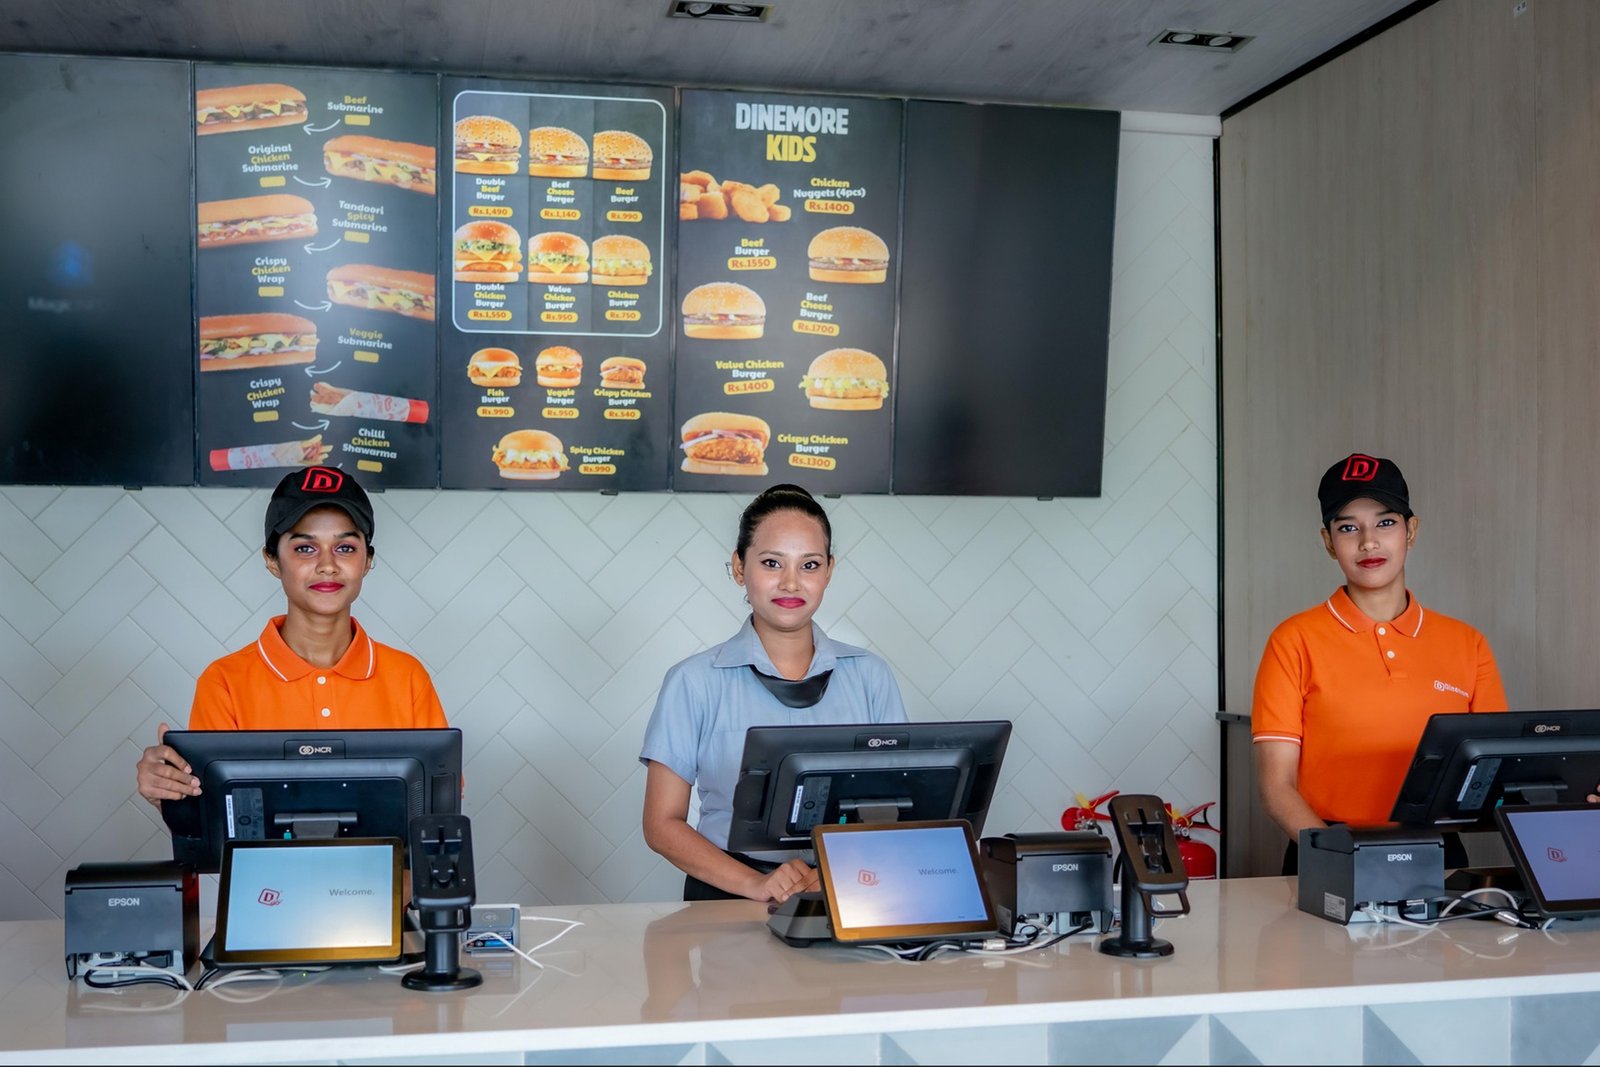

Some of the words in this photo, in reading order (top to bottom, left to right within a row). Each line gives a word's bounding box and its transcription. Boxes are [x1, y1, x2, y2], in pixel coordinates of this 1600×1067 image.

[344, 96, 367, 104] Beef
[328, 102, 384, 114] Submarine
[736, 103, 849, 135] DINEMORE
[248, 144, 292, 154] Original
[766, 134, 816, 163] KIDS
[251, 153, 290, 164] Chicken
[242, 163, 299, 173] Submarine
[476, 178, 505, 186] Double
[810, 178, 850, 188] Chicken
[547, 188, 575, 196] Cheese
[793, 189, 834, 199] Nuggets
[836, 188, 866, 198] (4pcs)
[476, 193, 504, 201] Burger
[546, 196, 575, 204] Burger
[610, 195, 639, 204] Burger
[339, 200, 384, 214] Tandoori
[809, 202, 850, 212] Rs.1400
[473, 208, 508, 216] Rs.1,490
[544, 210, 576, 219] Rs.1,140
[347, 212, 374, 222] Spicy
[332, 219, 387, 232] Submarine
[741, 238, 764, 247] Beef
[735, 246, 770, 257] Burger
[255, 257, 287, 266] Crispy
[732, 259, 770, 268] Rs.1550
[252, 265, 291, 276] Chicken
[257, 276, 285, 284] Wrap
[475, 283, 504, 291] Double
[548, 285, 571, 293] Value
[474, 291, 506, 300] Chicken
[544, 293, 575, 302] Chicken
[608, 291, 639, 300] Chicken
[806, 292, 828, 301] Beef
[476, 300, 504, 309] Burger
[545, 302, 573, 311] Burger
[609, 299, 637, 308] Burger
[800, 300, 833, 311] Cheese
[473, 311, 506, 319] Rs.1,550
[800, 309, 833, 320] Burger
[798, 323, 834, 334] Rs.1700
[350, 328, 383, 340] Veggie
[337, 336, 393, 349] Submarine
[716, 360, 744, 369] Value
[745, 360, 784, 369] Chicken
[732, 369, 767, 379] Burger
[250, 378, 281, 389] Crispy
[728, 382, 768, 392] Rs.1400
[247, 386, 285, 401] Chicken
[547, 389, 575, 397] Veggie
[594, 389, 620, 398] Crispy
[620, 390, 652, 398] Chicken
[252, 398, 279, 409] Wrap
[482, 396, 510, 404] Burger
[546, 397, 575, 405] Burger
[608, 398, 636, 406] Burger
[482, 408, 509, 416] Rs.990
[358, 428, 385, 439] Chilli
[352, 437, 390, 448] Chicken
[777, 434, 809, 444] Crispy
[810, 435, 848, 445] Chicken
[342, 443, 397, 459] Shawarma
[570, 446, 591, 456] Spicy
[592, 447, 624, 456] Chicken
[795, 444, 829, 454] Burger
[583, 455, 610, 464] Burger
[792, 456, 830, 467] Rs.1300
[1387, 854, 1412, 862] EPSON
[1052, 864, 1078, 872] EPSON
[329, 888, 375, 896] Welcome.
[109, 898, 140, 906] EPSON
